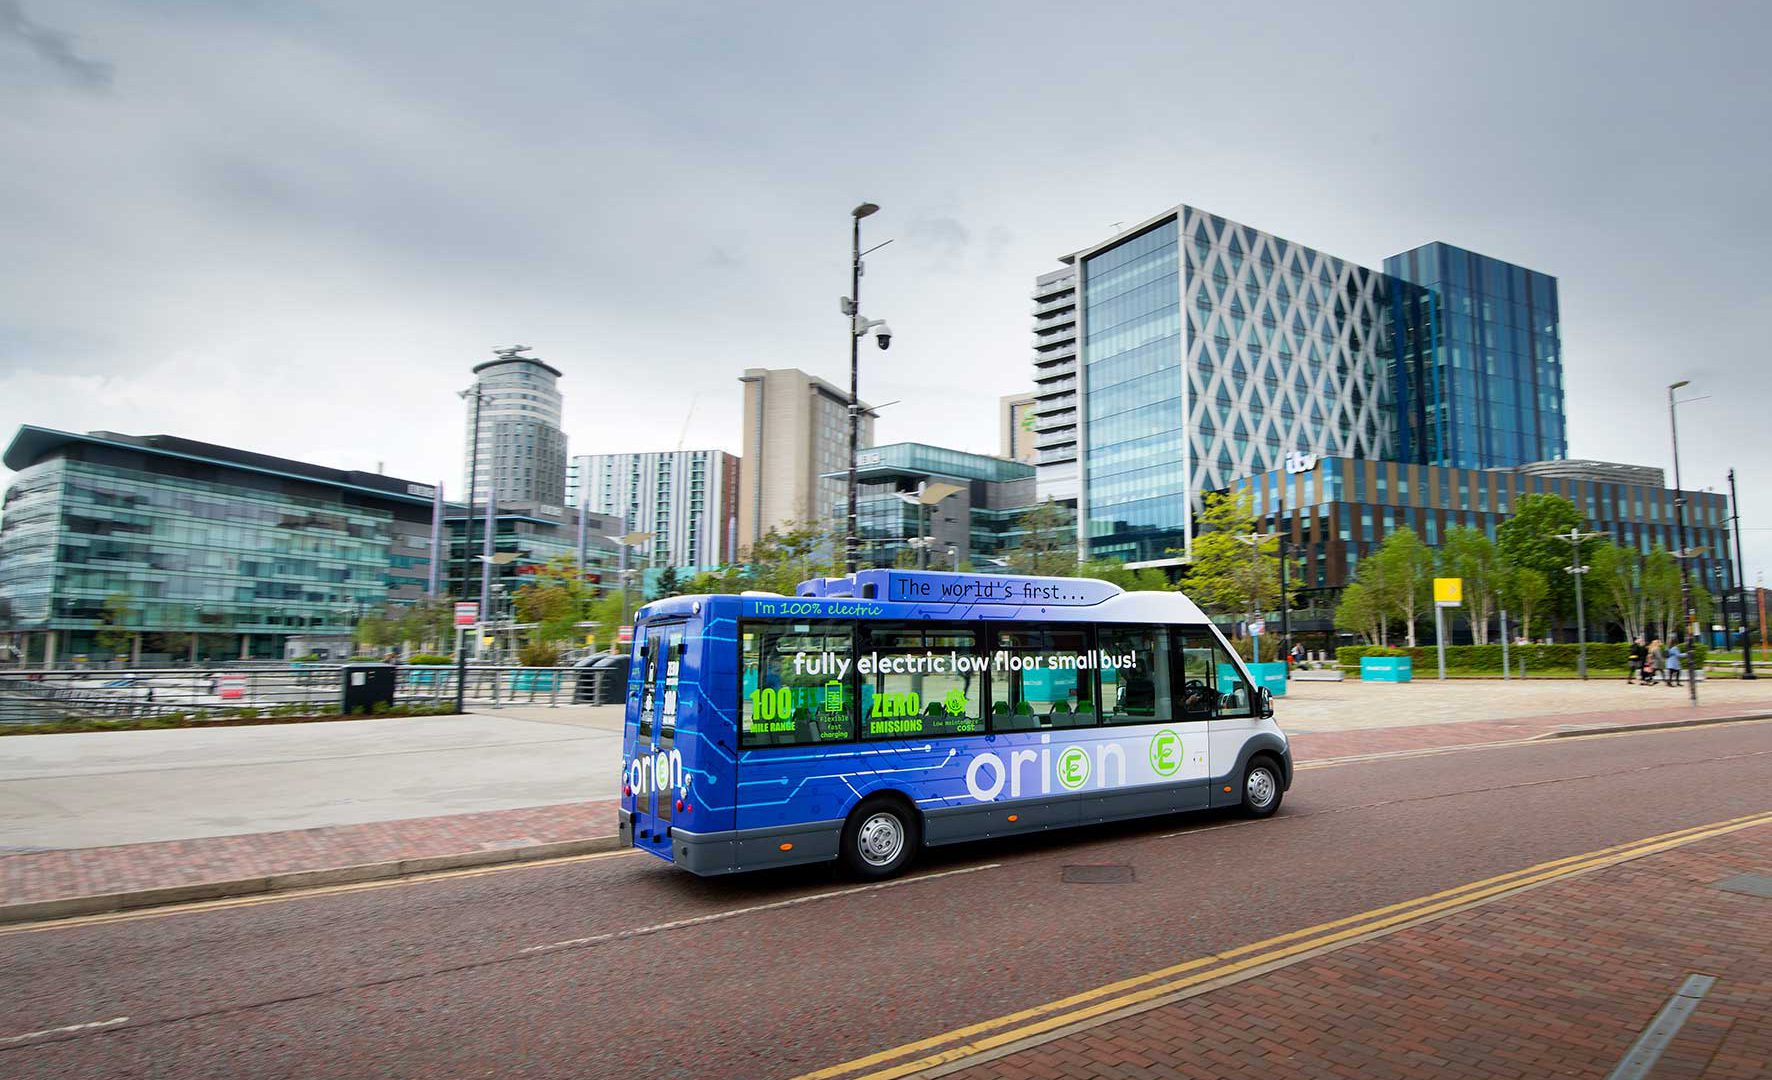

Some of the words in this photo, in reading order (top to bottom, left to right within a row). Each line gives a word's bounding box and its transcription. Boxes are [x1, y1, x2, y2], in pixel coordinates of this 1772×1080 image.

[898, 579, 930, 596] The
[942, 581, 1013, 598] world's
[1024, 583, 1085, 600] first...
[755, 601, 775, 615] I'm
[780, 602, 822, 615] 100%
[827, 602, 883, 617] electric
[793, 651, 851, 680] fully
[857, 651, 945, 674] electric
[951, 650, 989, 672] low
[995, 650, 1043, 671] floor
[1048, 649, 1098, 670] small
[1100, 648, 1137, 669] bus!
[750, 686, 792, 721] 100
[871, 692, 920, 718] ZERO
[750, 723, 769, 734] MILE
[770, 721, 796, 732] RANGE
[870, 719, 923, 734] EMISSIONS
[957, 724, 976, 732] cost
